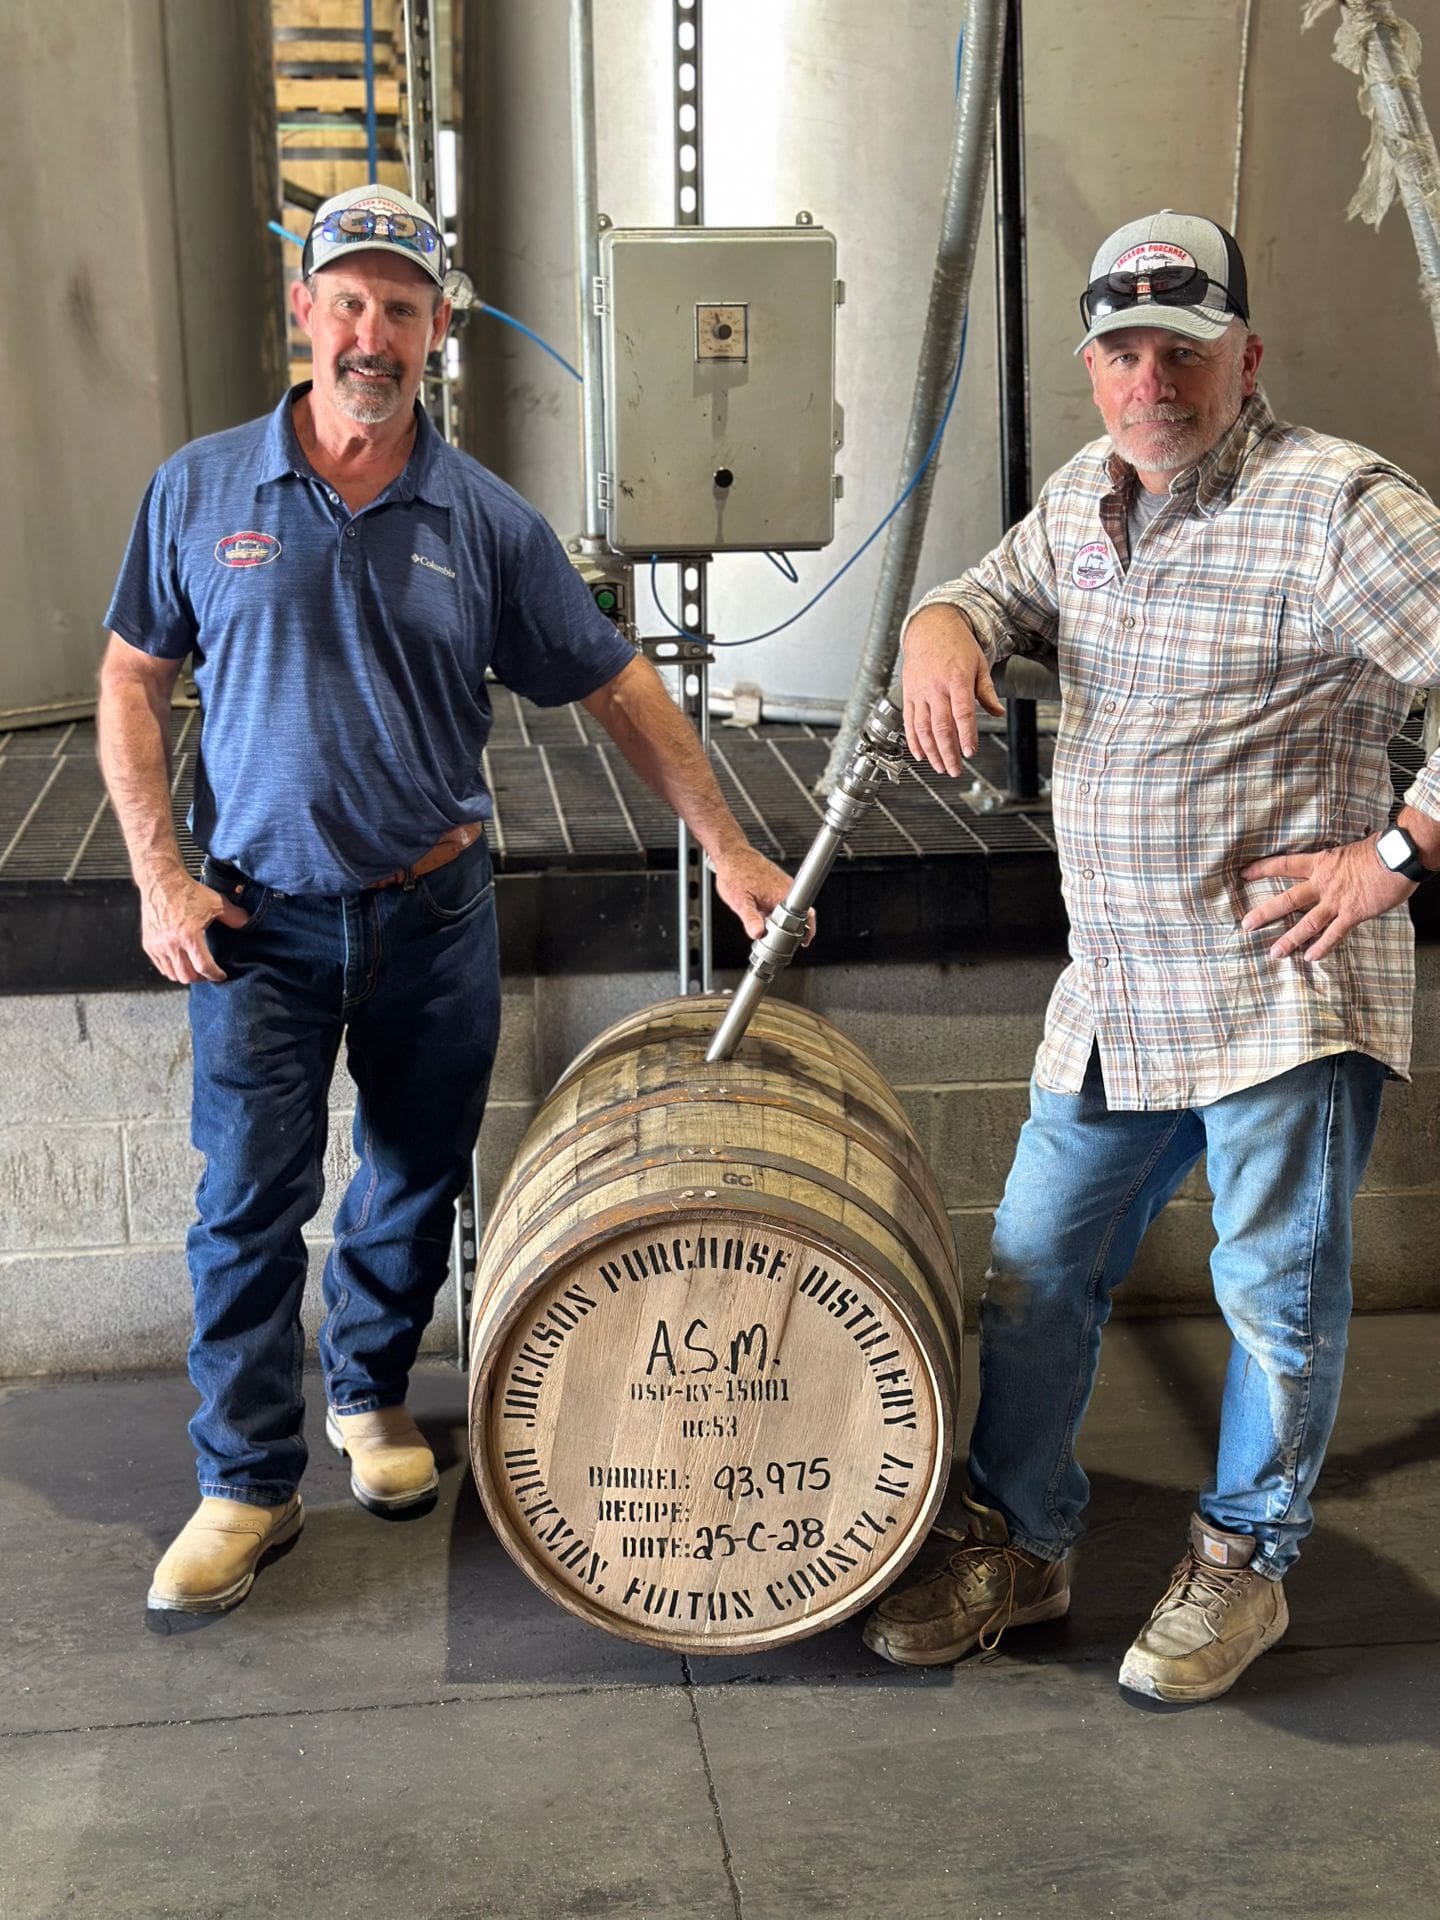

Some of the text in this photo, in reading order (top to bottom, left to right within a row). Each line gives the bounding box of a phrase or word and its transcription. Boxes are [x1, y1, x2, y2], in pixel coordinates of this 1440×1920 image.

[1117, 245, 1187, 268] JACKSON PURCHASE
[419, 556, 456, 578] Columbia
[722, 1172, 754, 1187] GC
[503, 1237, 917, 1430] JACKSON PURCHASE DISTILLERY
[630, 1378, 790, 1402] DSP-KY-15001
[588, 1457, 831, 1501] BARREL: 93,975
[598, 1499, 690, 1523] RECIPE:
[503, 1448, 914, 1621] HICKMAN, FULTON COUNTY, KY
[622, 1517, 826, 1561] DATE: 25-C-28
